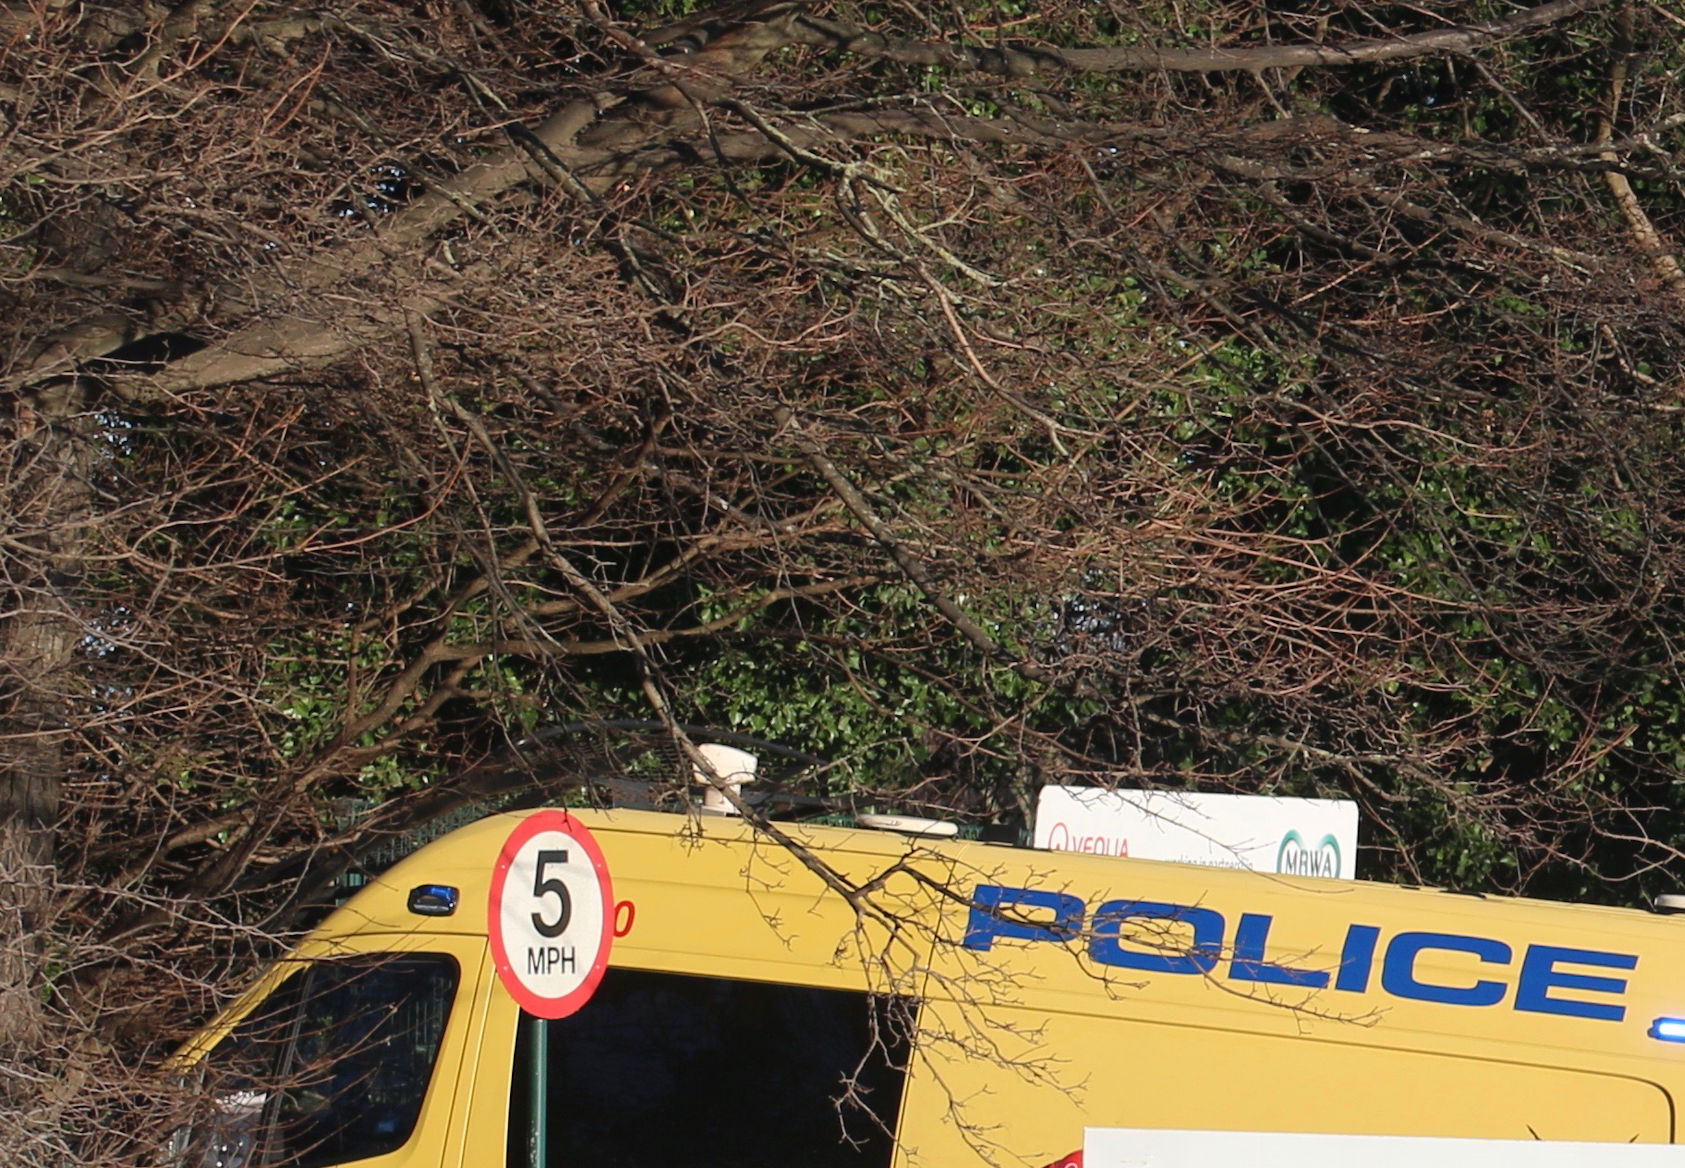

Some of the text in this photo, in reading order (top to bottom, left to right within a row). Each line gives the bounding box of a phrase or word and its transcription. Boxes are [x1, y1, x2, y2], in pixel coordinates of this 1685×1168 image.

[531, 849, 572, 939] 5
[527, 946, 576, 975] MPH
[962, 883, 1639, 1022] POLICE
